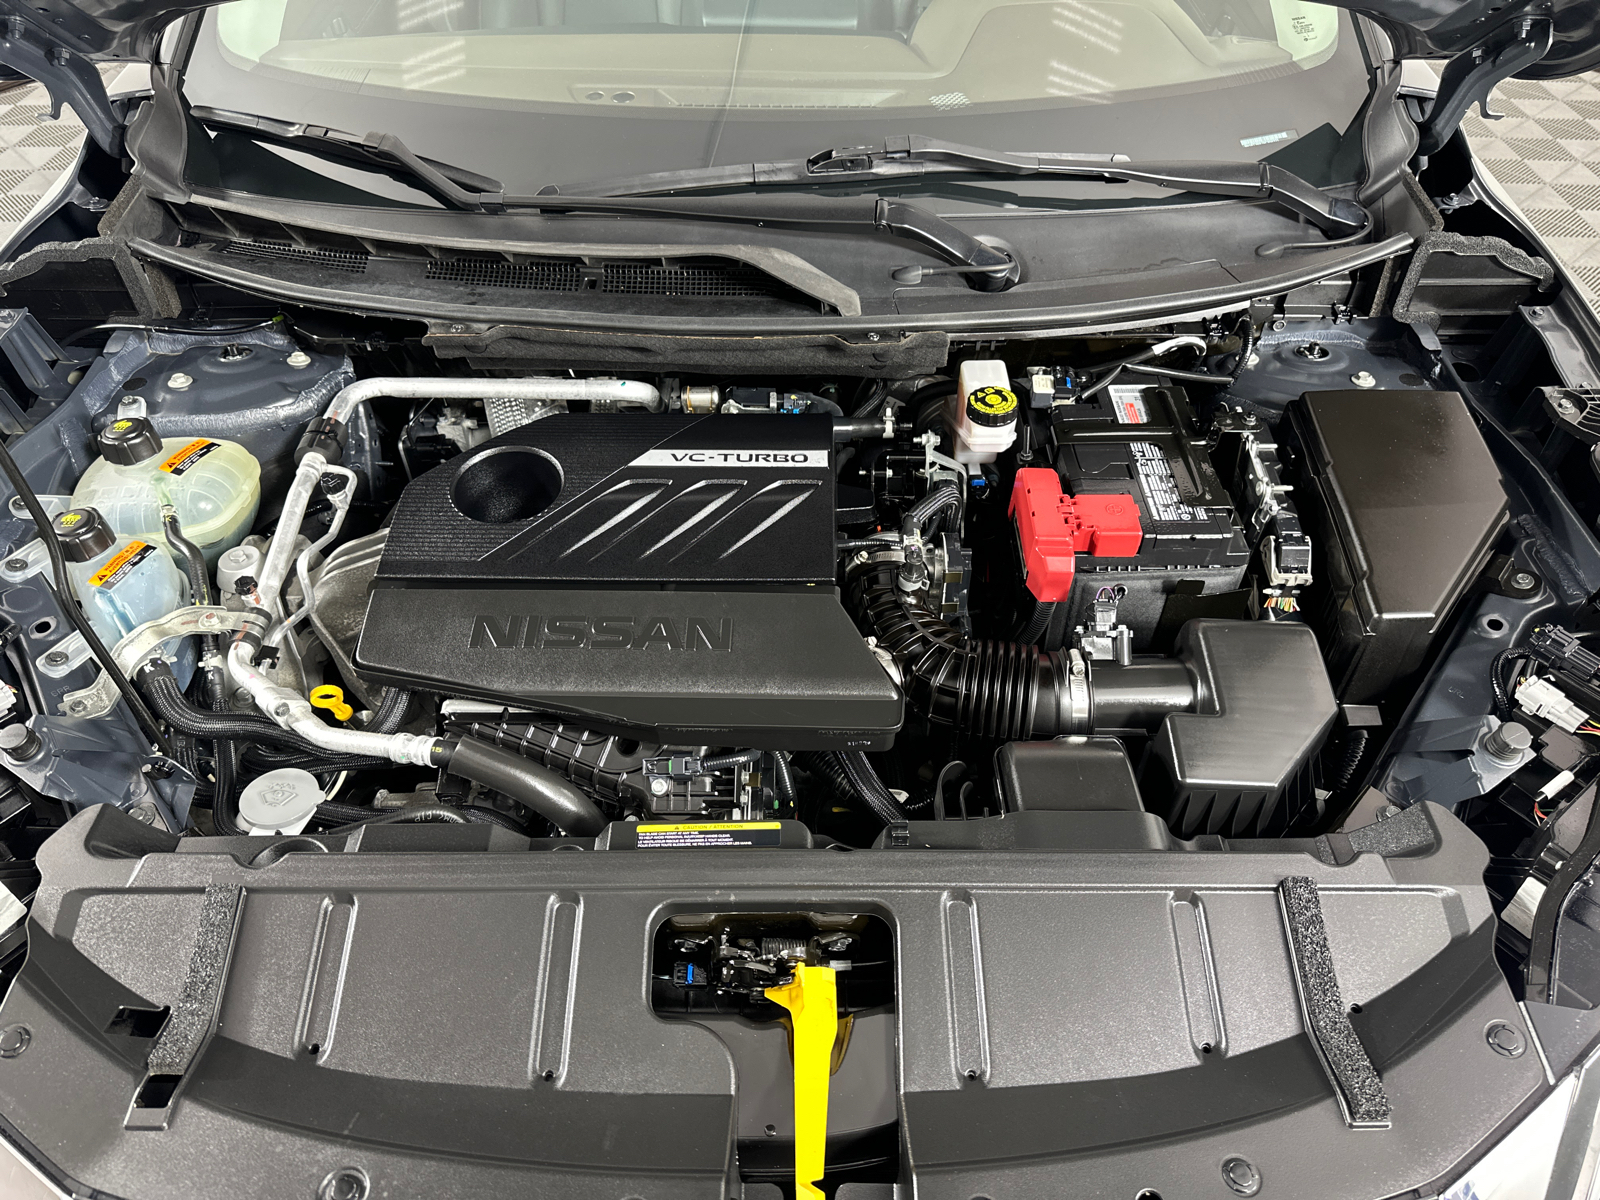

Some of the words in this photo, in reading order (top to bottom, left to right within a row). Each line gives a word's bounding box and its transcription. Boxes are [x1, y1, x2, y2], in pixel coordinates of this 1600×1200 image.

[670, 453, 809, 463] VC-TURBO
[467, 614, 734, 652] NISSAN
[143, 662, 155, 674] K
